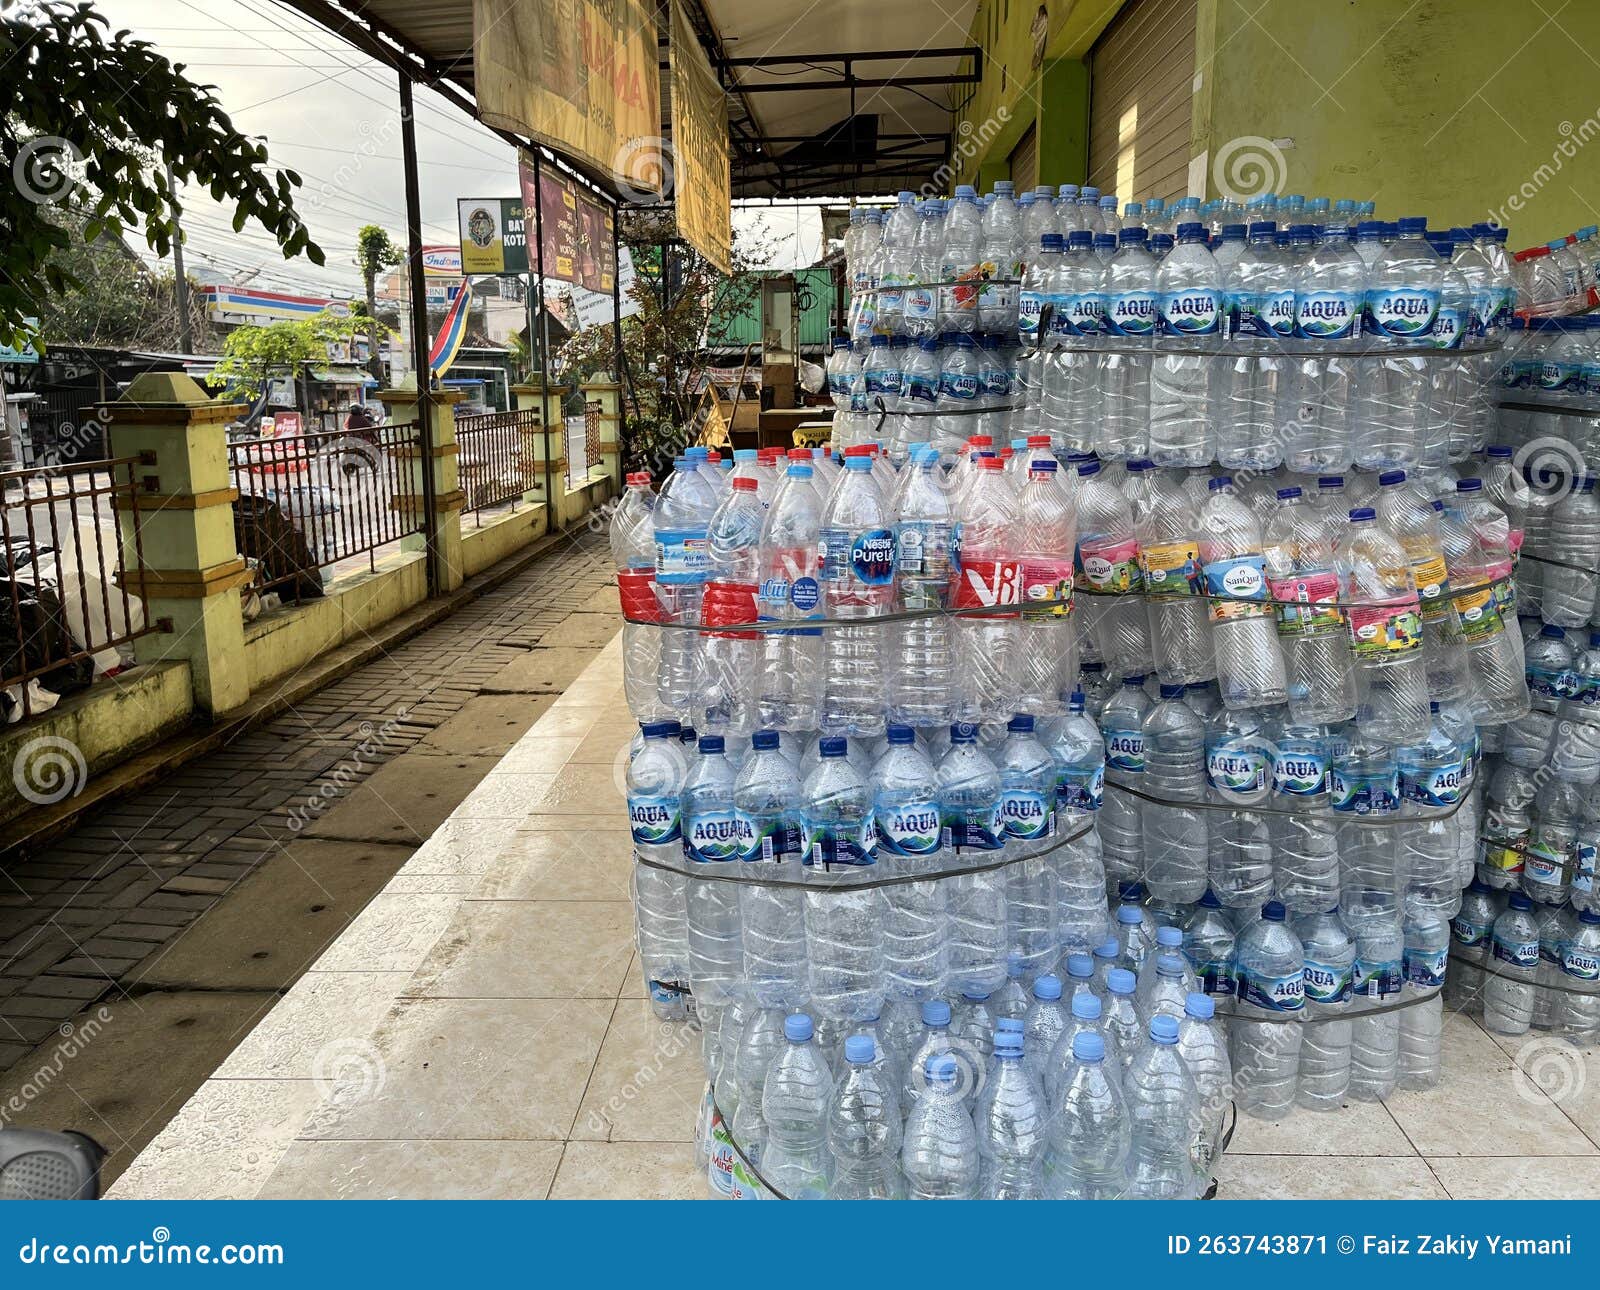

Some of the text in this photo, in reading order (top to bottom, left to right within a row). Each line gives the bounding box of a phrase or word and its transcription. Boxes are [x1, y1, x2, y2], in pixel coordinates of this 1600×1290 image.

[1170, 297, 1215, 317] AQUA
[1301, 300, 1347, 320] AQUA
[1380, 298, 1429, 318] AQUA
[853, 549, 883, 563] Pure
[1225, 575, 1260, 586] SanQua
[1111, 737, 1143, 756] AQU
[1209, 755, 1250, 776] AQUA
[1276, 761, 1319, 778] AQUA
[694, 820, 737, 842] AQUA
[893, 811, 938, 834] AQUA
[1568, 955, 1598, 970] AQUA
[1273, 979, 1304, 996] AQU
